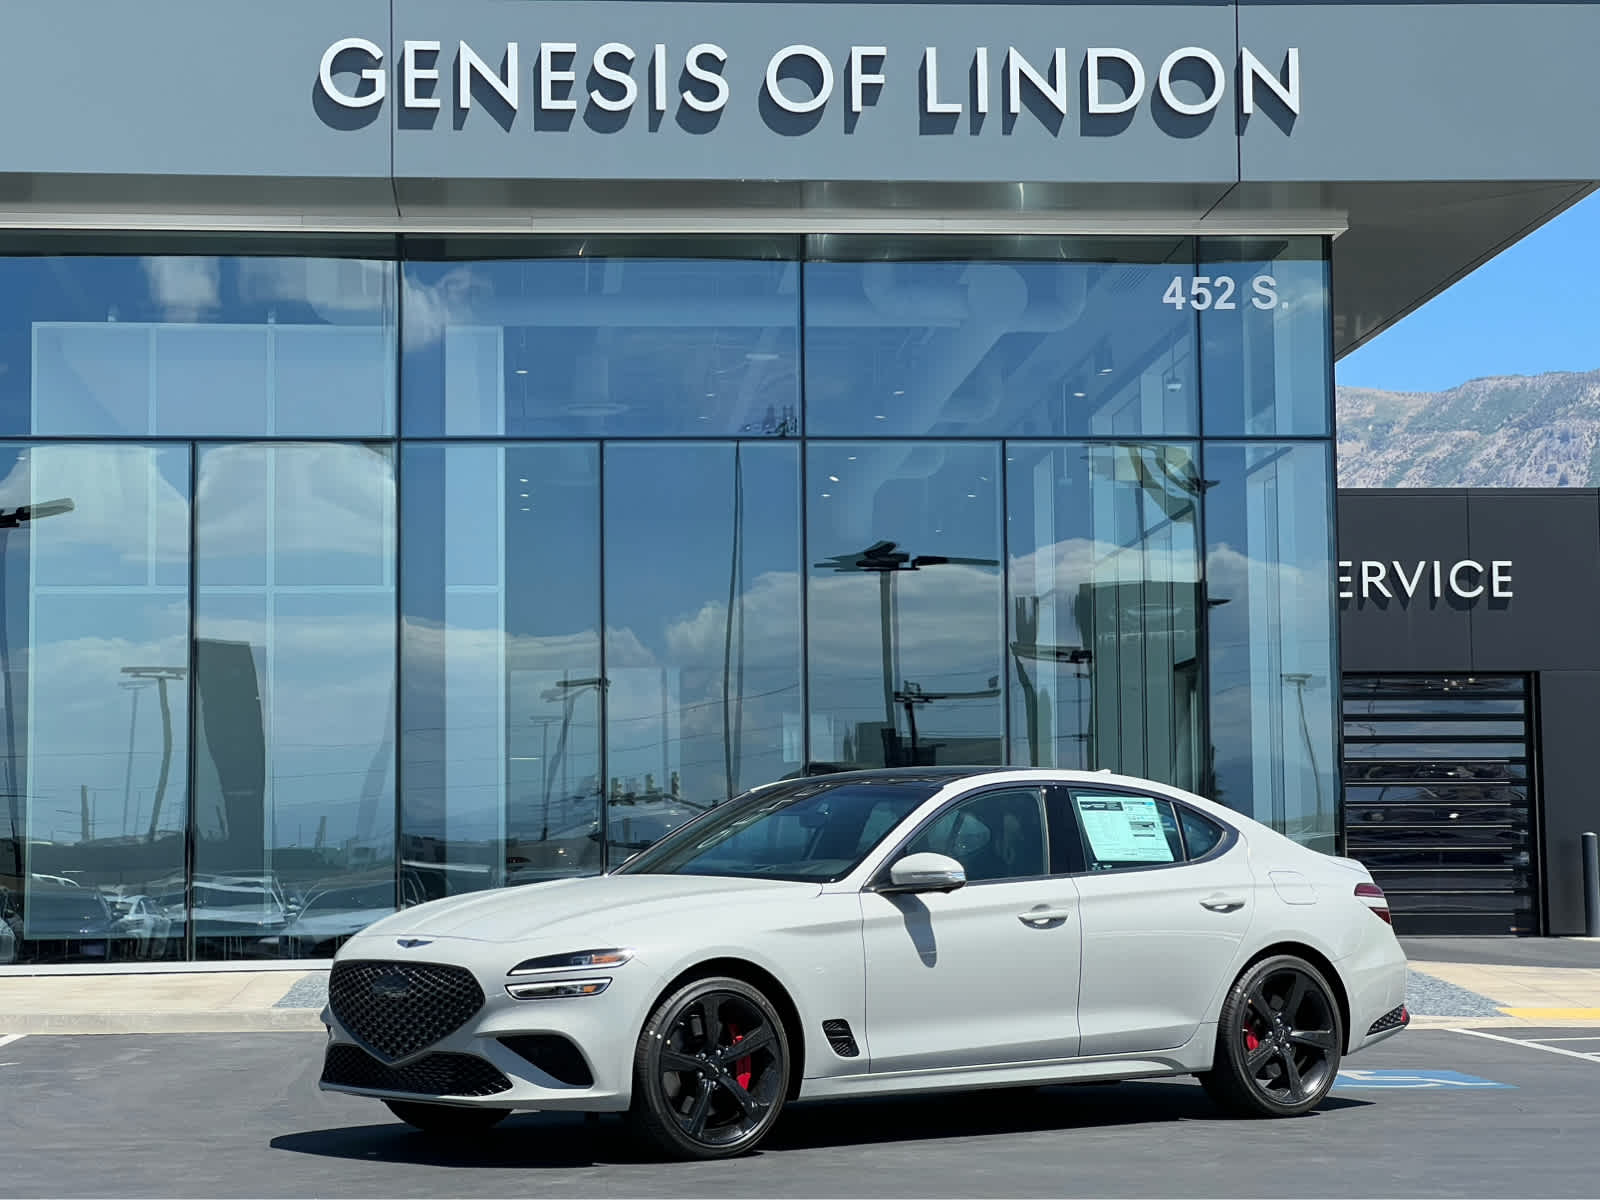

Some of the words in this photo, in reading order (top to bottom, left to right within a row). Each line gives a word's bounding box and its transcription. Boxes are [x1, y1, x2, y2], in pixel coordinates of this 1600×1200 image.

[319, 37, 729, 112] GENESIS
[766, 44, 887, 113] OF
[926, 46, 1300, 115] LINDON
[1162, 275, 1237, 311] 452
[1251, 275, 1289, 311] S.
